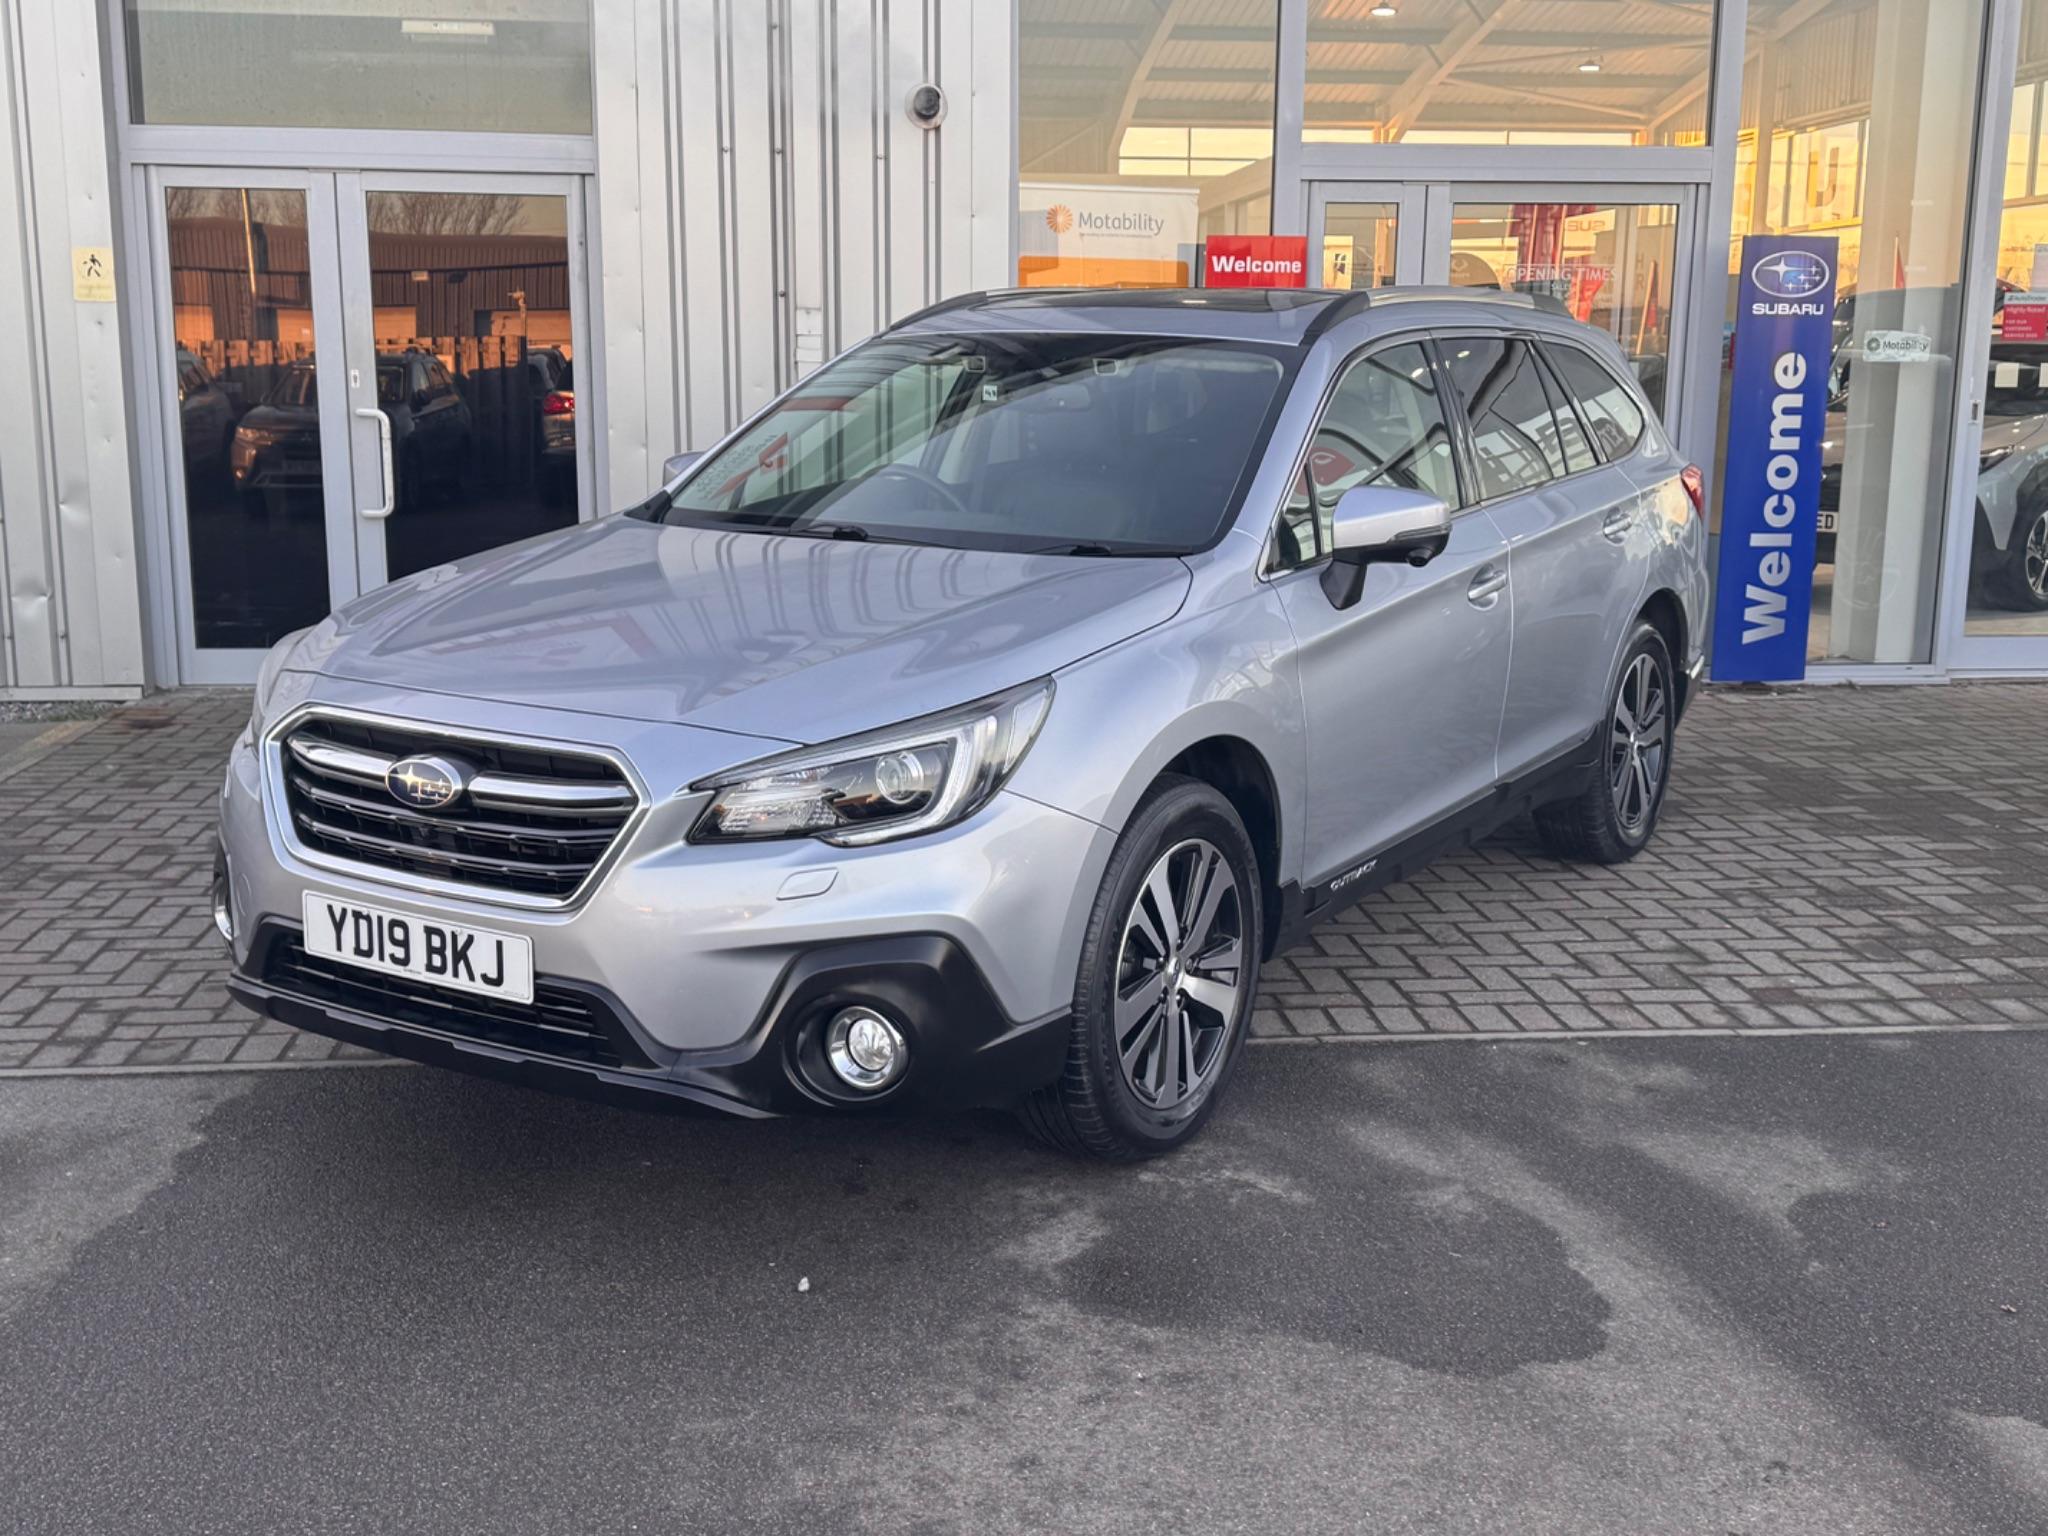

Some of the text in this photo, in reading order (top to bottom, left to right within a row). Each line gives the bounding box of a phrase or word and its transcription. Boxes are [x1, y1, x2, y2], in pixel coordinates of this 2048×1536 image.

[1078, 211, 1165, 236] Motability
[1212, 255, 1302, 273] Welcome
[1506, 266, 1617, 281] OPENING TIMES
[1752, 303, 1824, 315] SUBARU
[1742, 352, 1807, 645] Welcome
[327, 904, 504, 987] YD19 BKJ
